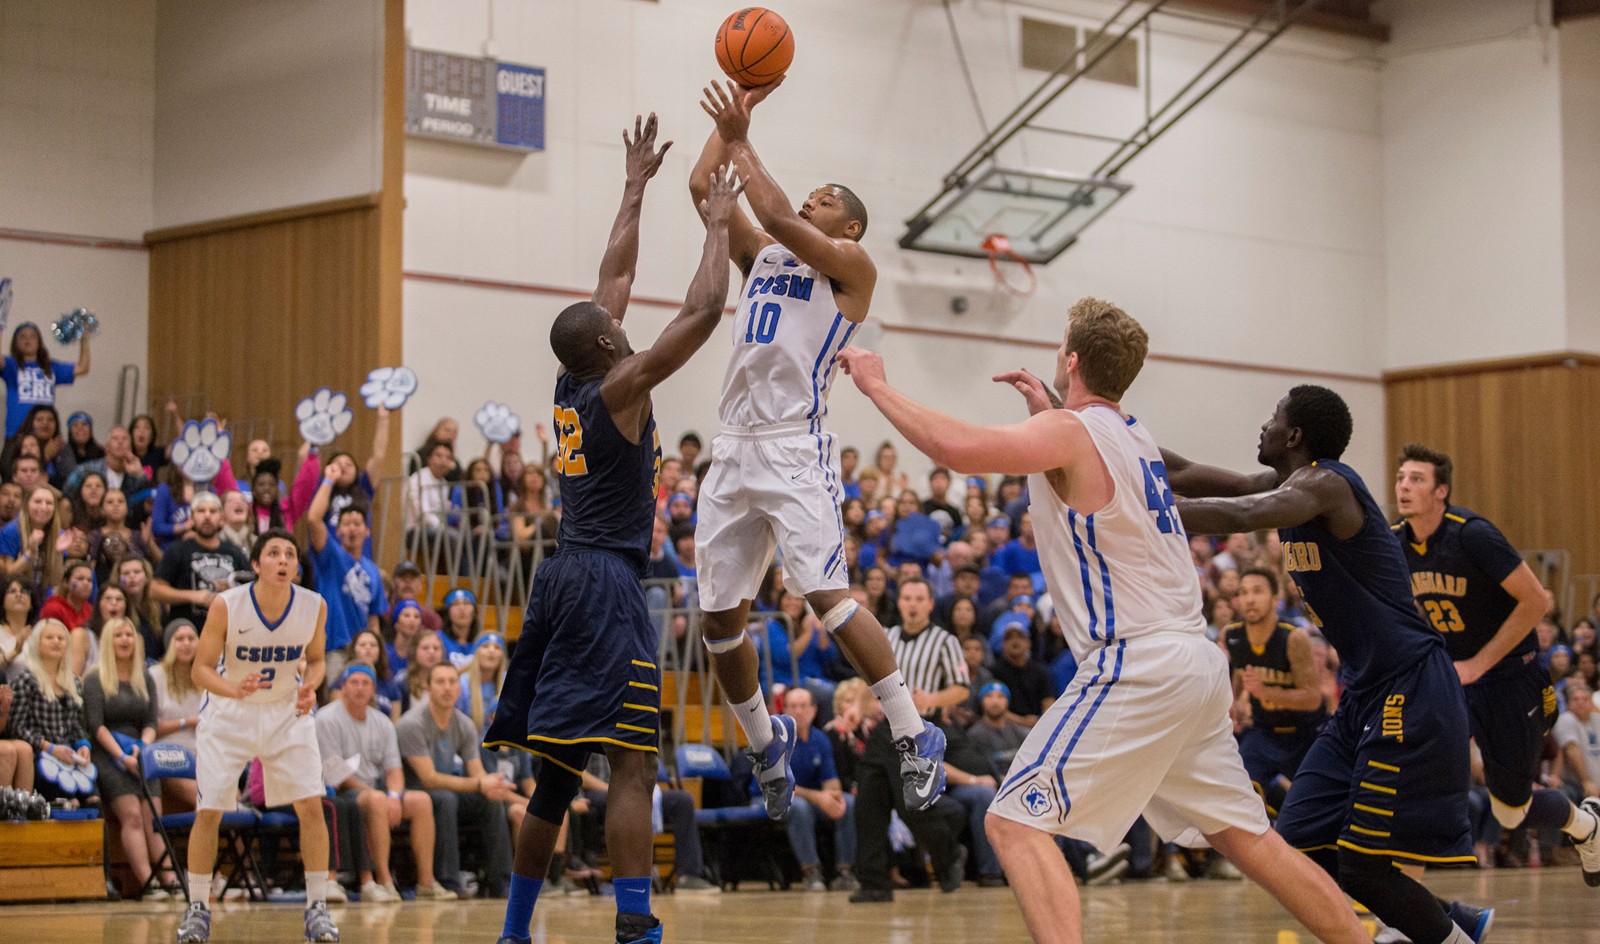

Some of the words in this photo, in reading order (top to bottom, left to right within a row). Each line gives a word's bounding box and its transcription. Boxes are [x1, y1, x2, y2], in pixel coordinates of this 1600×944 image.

[497, 69, 543, 98] GUEST
[424, 92, 472, 116] TIME
[745, 301, 782, 344] 10
[554, 404, 588, 477] 32
[1138, 456, 1184, 537] 42
[1423, 599, 1466, 632] 23
[236, 645, 303, 663] CSUSM
[260, 667, 276, 690] 2
